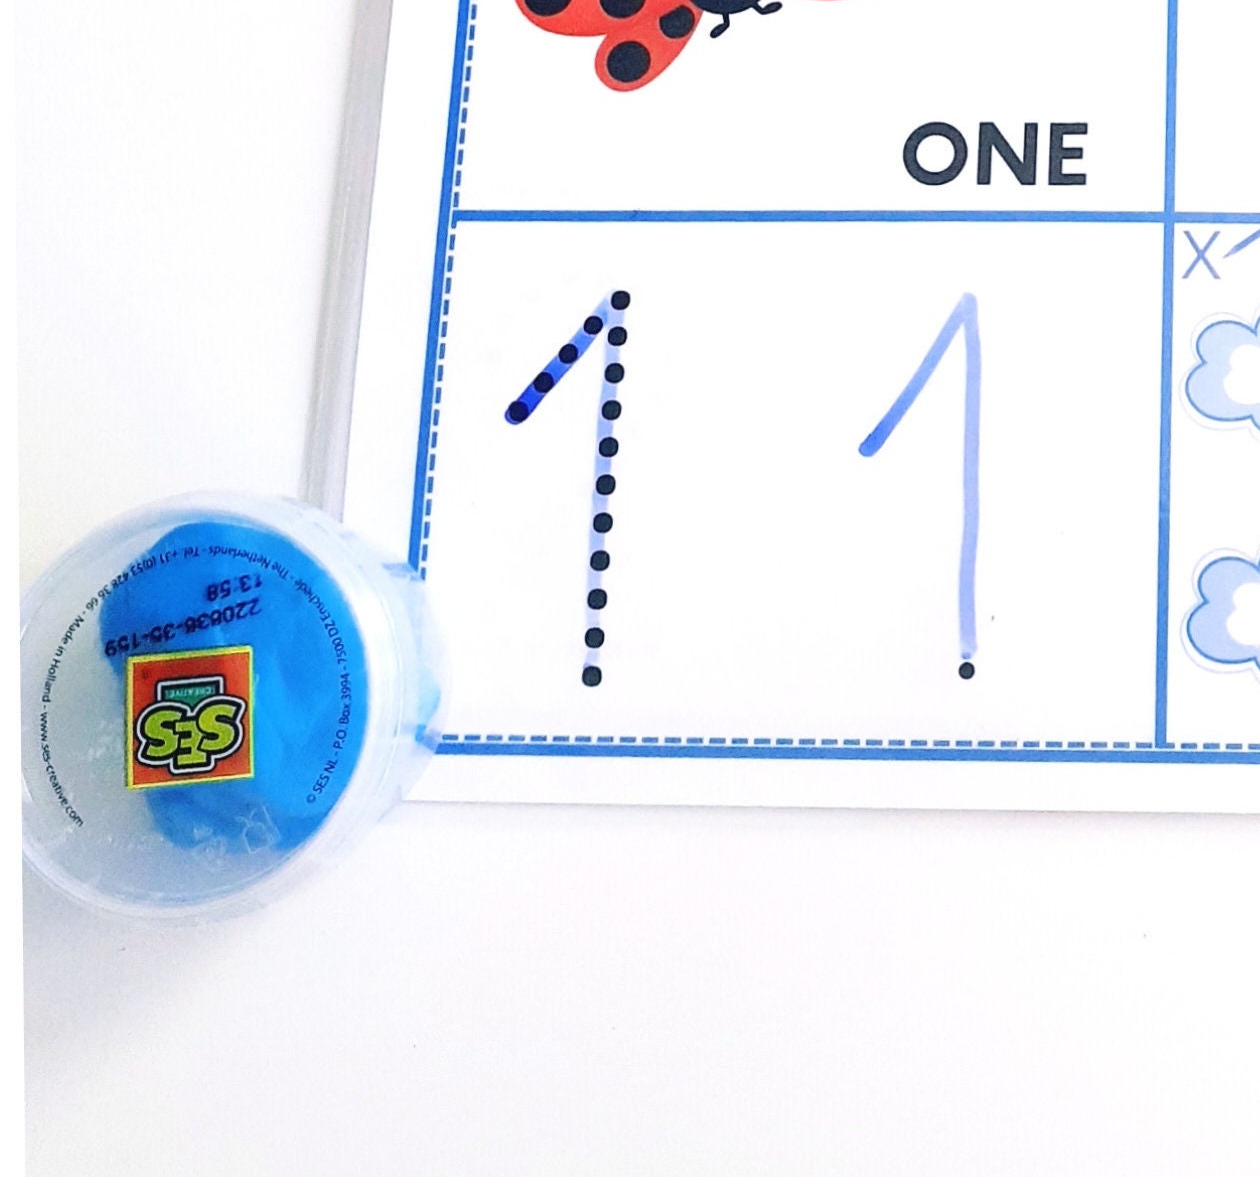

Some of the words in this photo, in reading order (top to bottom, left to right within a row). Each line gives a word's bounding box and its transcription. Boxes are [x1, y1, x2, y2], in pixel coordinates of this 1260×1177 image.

[902, 121, 1088, 186] ONE
[130, 556, 156, 577] (0)53
[160, 550, 177, 564] +31
[209, 545, 271, 569] Netherlands
[111, 571, 129, 589] 428
[271, 562, 289, 579] The
[98, 585, 112, 600] 36
[295, 579, 332, 621] Enschede
[85, 597, 99, 612] 66
[62, 614, 84, 646] Made
[324, 620, 339, 638] DZ
[55, 645, 66, 658] in
[332, 637, 347, 664] 7500
[42, 658, 61, 703] Holland
[340, 673, 352, 701] 3994
[338, 705, 351, 725] Box
[142, 701, 239, 768] SES
[324, 760, 338, 774] NL
[313, 774, 330, 794] SES
